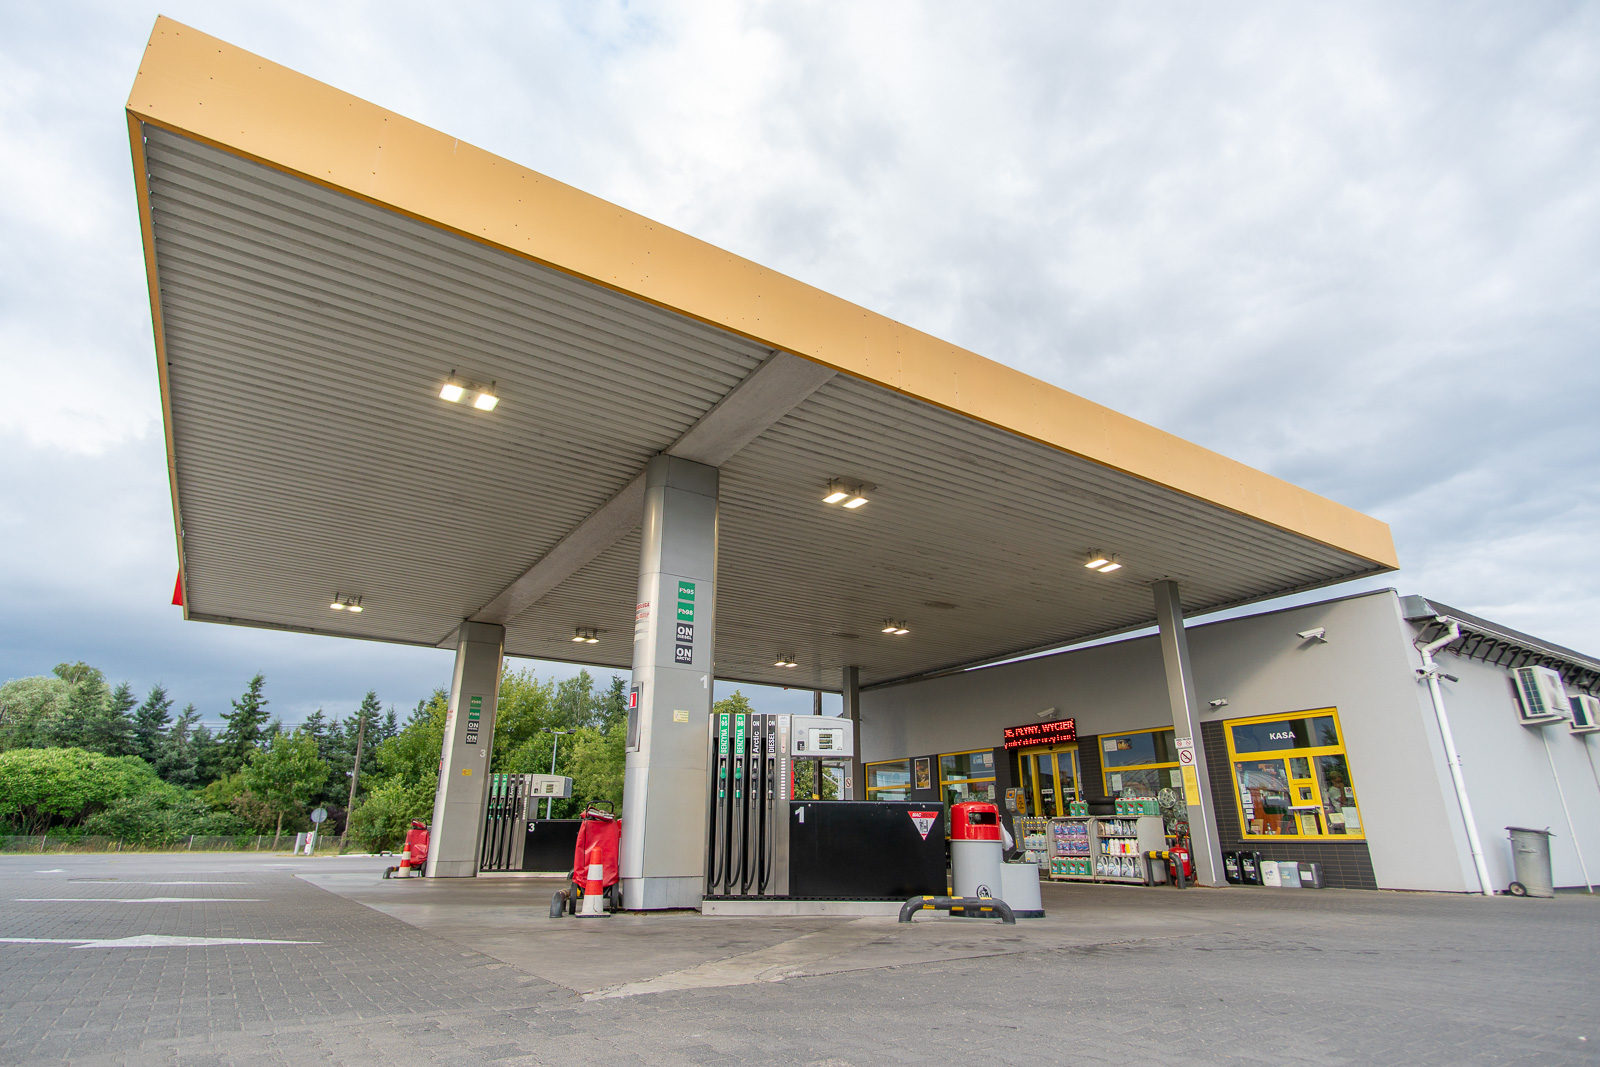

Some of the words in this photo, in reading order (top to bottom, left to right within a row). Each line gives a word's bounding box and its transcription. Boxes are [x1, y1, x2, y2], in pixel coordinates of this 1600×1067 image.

[677, 626, 693, 636] ON
[676, 647, 692, 657] ON
[700, 675, 708, 689] 1
[720, 728, 728, 754] BENZYNA
[736, 728, 744, 754] BENZYNA
[1269, 731, 1296, 740] KASA
[752, 731, 760, 753] Arctic
[480, 749, 486, 758] 3
[794, 806, 805, 823] 1
[528, 822, 536, 832] 3
